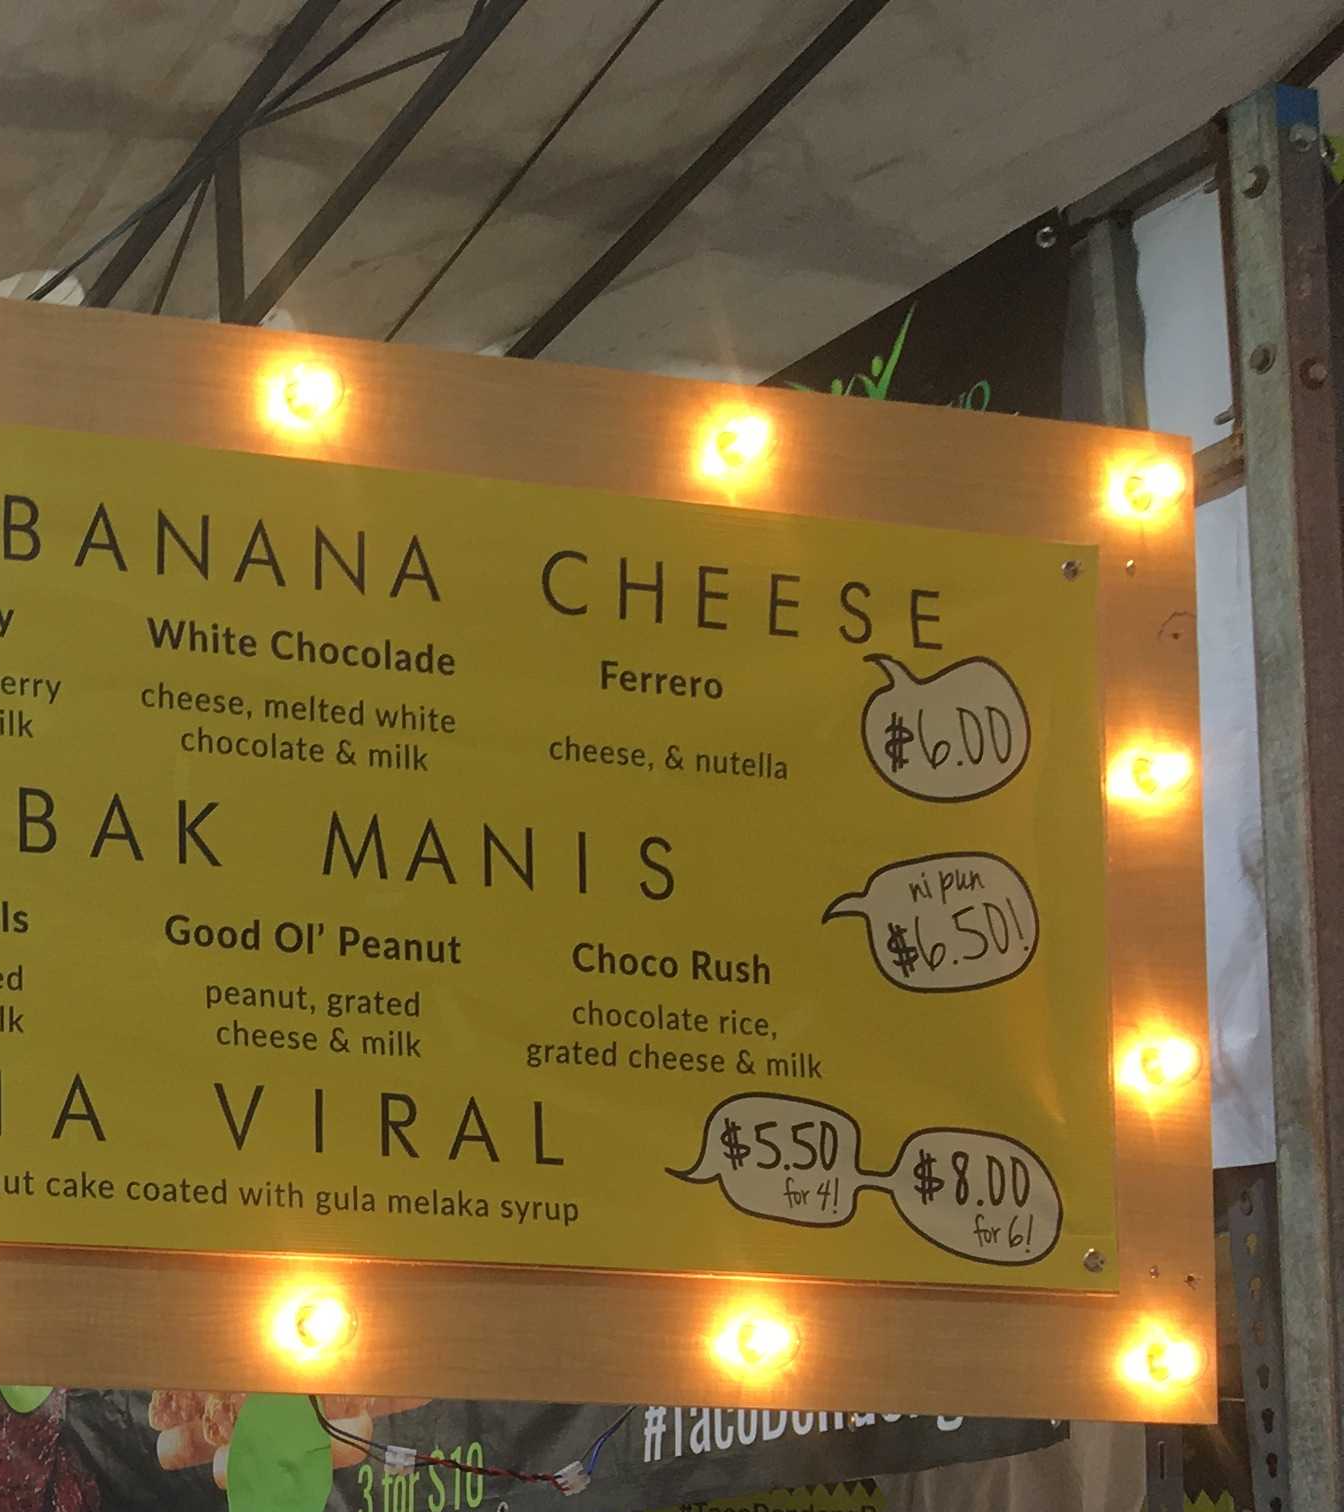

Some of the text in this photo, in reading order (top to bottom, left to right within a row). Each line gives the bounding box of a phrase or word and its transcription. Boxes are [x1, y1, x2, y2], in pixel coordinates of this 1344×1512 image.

[3, 493, 442, 603] BANANA
[541, 549, 943, 651] CHEESE
[146, 616, 456, 676] White Chocolade
[600, 659, 724, 700] Ferrero
[140, 681, 456, 734] cheese, melted white
[180, 726, 429, 772] chocolate & milk
[548, 735, 788, 780] cheese, & nutella
[884, 705, 1012, 774] $6.00
[321, 810, 675, 901] MANIS
[908, 869, 985, 905] ni pun
[164, 914, 462, 965] Good Ol' Peanut
[886, 897, 1030, 978] $6.50!
[571, 942, 771, 985] Choco Rush
[205, 984, 420, 1018] peanut, grated
[572, 999, 777, 1041] chocolate rice,
[216, 1019, 422, 1058] cheese & milk
[526, 1040, 822, 1079] grated cheese & milk
[213, 1082, 565, 1167] VIRAL
[719, 1117, 839, 1172] $5.50
[45, 1170, 115, 1200] cake
[125, 1178, 228, 1205] coated
[238, 1181, 304, 1209] with
[315, 1184, 376, 1216] gula
[387, 1188, 489, 1218] melaka
[500, 1199, 579, 1227] syrup
[783, 1176, 839, 1215] for 4!
[913, 1148, 1031, 1208] $8.00
[973, 1213, 1034, 1254] for 6!
